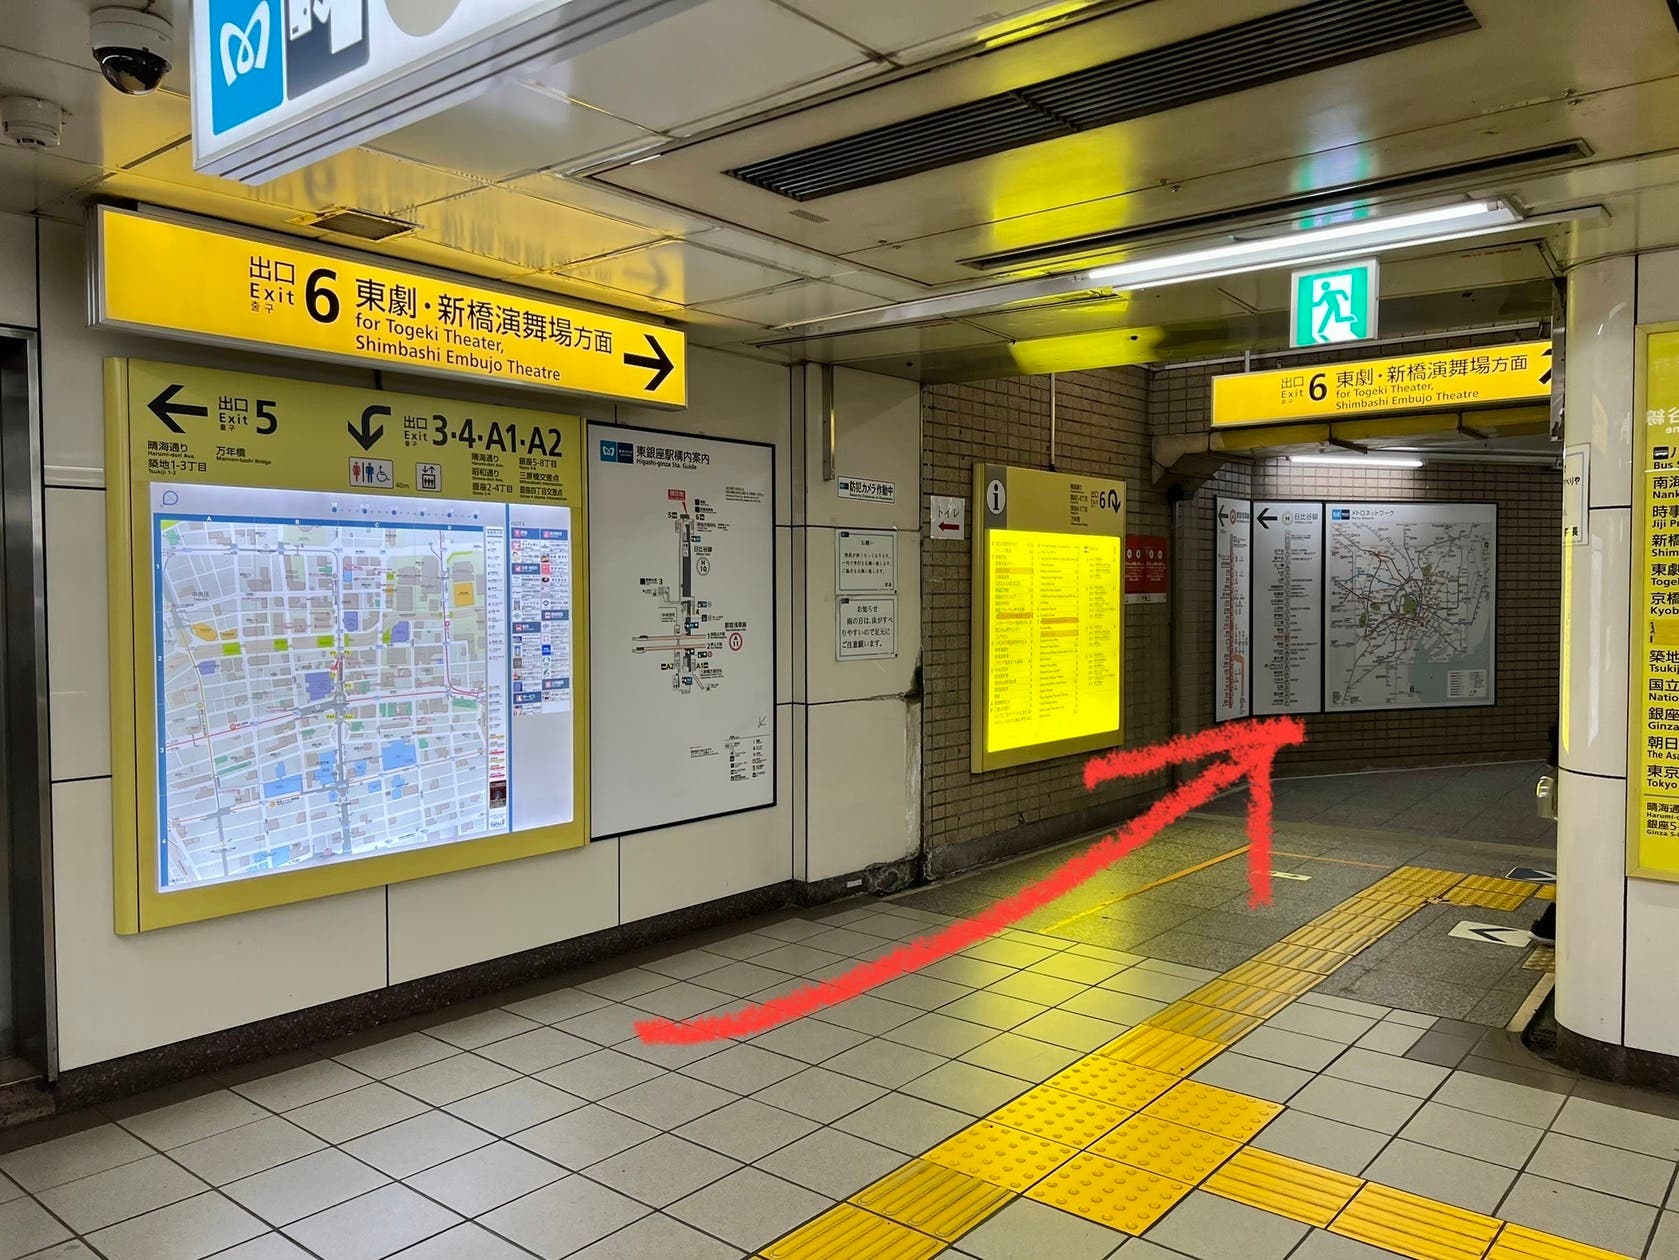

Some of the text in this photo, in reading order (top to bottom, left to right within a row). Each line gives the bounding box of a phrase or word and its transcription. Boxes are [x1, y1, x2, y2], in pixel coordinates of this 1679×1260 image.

[249, 255, 295, 286] 出口
[249, 282, 295, 306] Exit
[305, 268, 340, 323] 6
[355, 278, 613, 355] 東劇・新橋演舞場方面
[355, 312, 505, 355] for Togeki Theater,
[355, 334, 561, 381] Shimbashi Embujo Theatre
[1281, 375, 1304, 389] 出口
[1308, 372, 1328, 402] 6
[1281, 390, 1304, 399] Exit
[1336, 382, 1434, 399] for Togeki Theater,
[218, 396, 248, 412] 出口
[1336, 389, 1479, 410] Shimbashi Embujo Theatre
[219, 412, 249, 425] Exit
[256, 399, 278, 435] 5
[403, 415, 427, 430] 出口
[404, 430, 428, 442] Exit
[147, 440, 189, 453] 晴海通り
[216, 445, 246, 457] 万年橋
[636, 445, 710, 465] 東銀座駅構内案内
[148, 458, 207, 473] 築地1-3丁目
[1653, 461, 1673, 470] Bus
[1099, 491, 1106, 509] 6
[938, 505, 960, 519] トイレ
[1652, 519, 1667, 530] Jiji
[1651, 548, 1679, 557] Shim
[1649, 650, 1679, 663] 築地
[1649, 678, 1679, 692] 国立
[1648, 692, 1679, 702] Natio
[1648, 707, 1679, 721] 銀座
[1648, 721, 1679, 731] Ginza
[1647, 736, 1678, 750] 朝日
[1647, 750, 1664, 759] The
[1647, 764, 1679, 779] 東京
[1646, 779, 1677, 790] Tokyo
